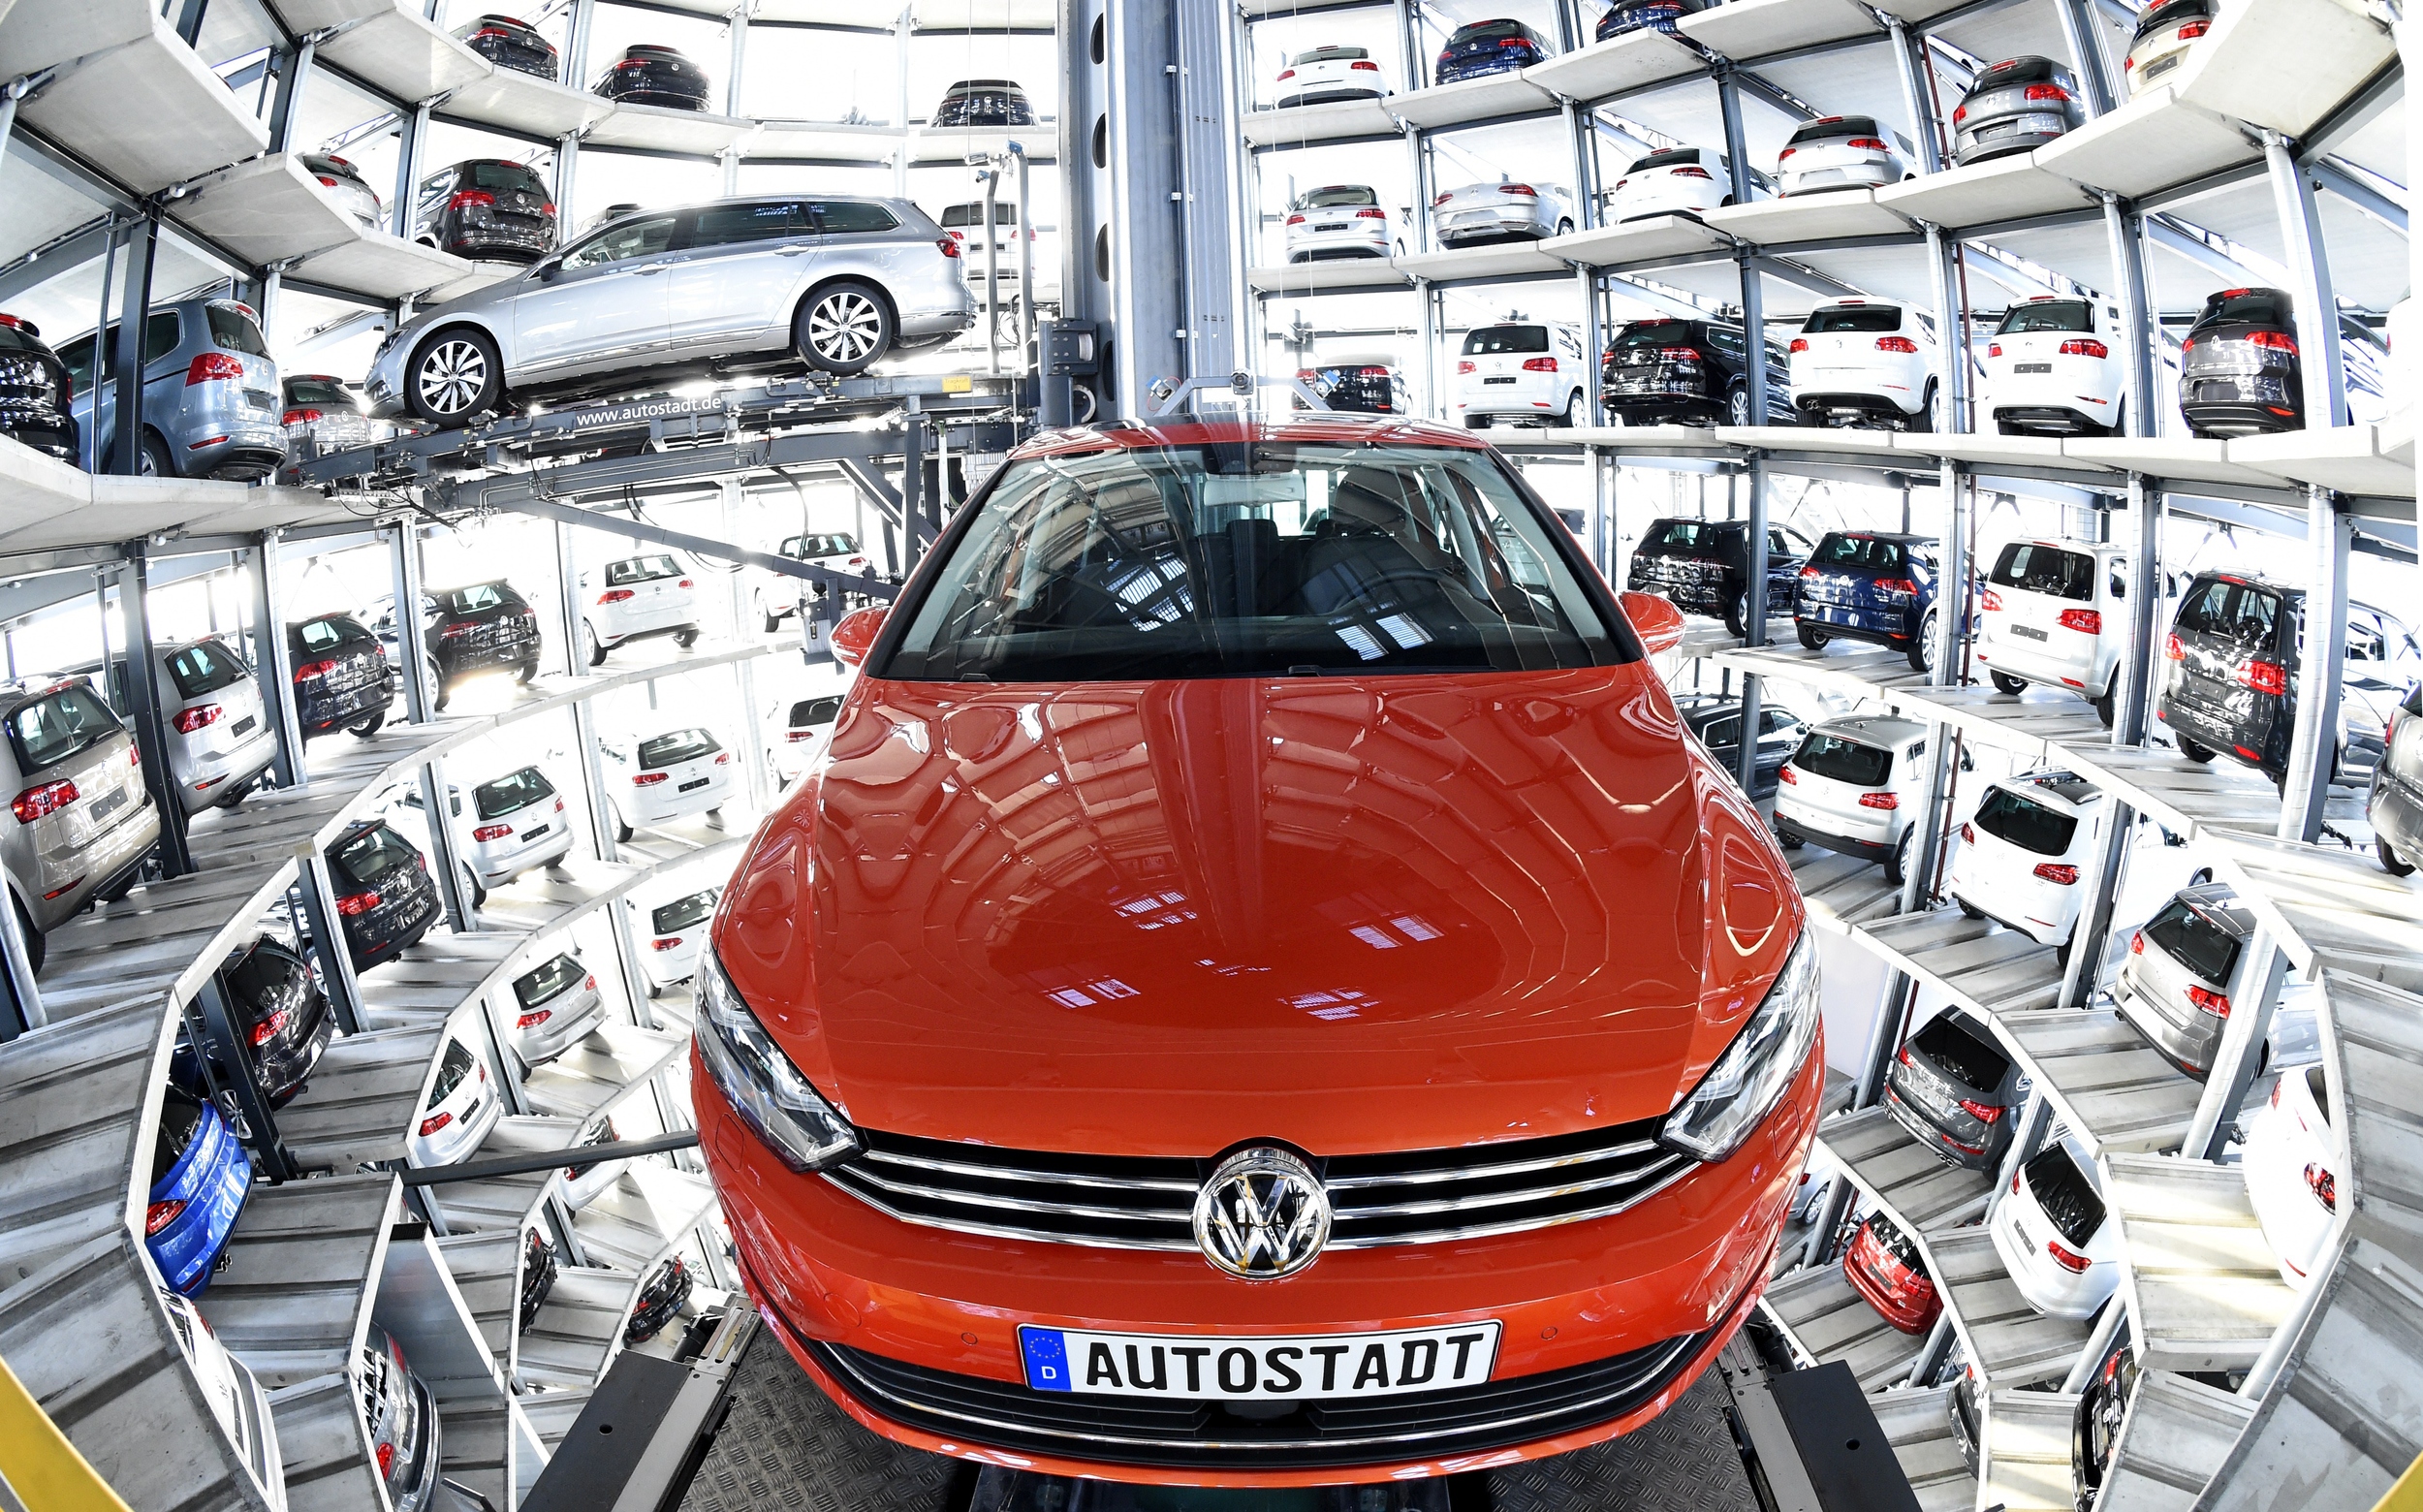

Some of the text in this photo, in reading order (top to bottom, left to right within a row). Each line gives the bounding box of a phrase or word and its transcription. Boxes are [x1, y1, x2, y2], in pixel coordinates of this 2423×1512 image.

[576, 395, 722, 426] www.autostadt.de
[1202, 1166, 1322, 1277] VW
[1041, 1366, 1057, 1380] D
[1086, 1333, 1485, 1393] AUTOSTADT
